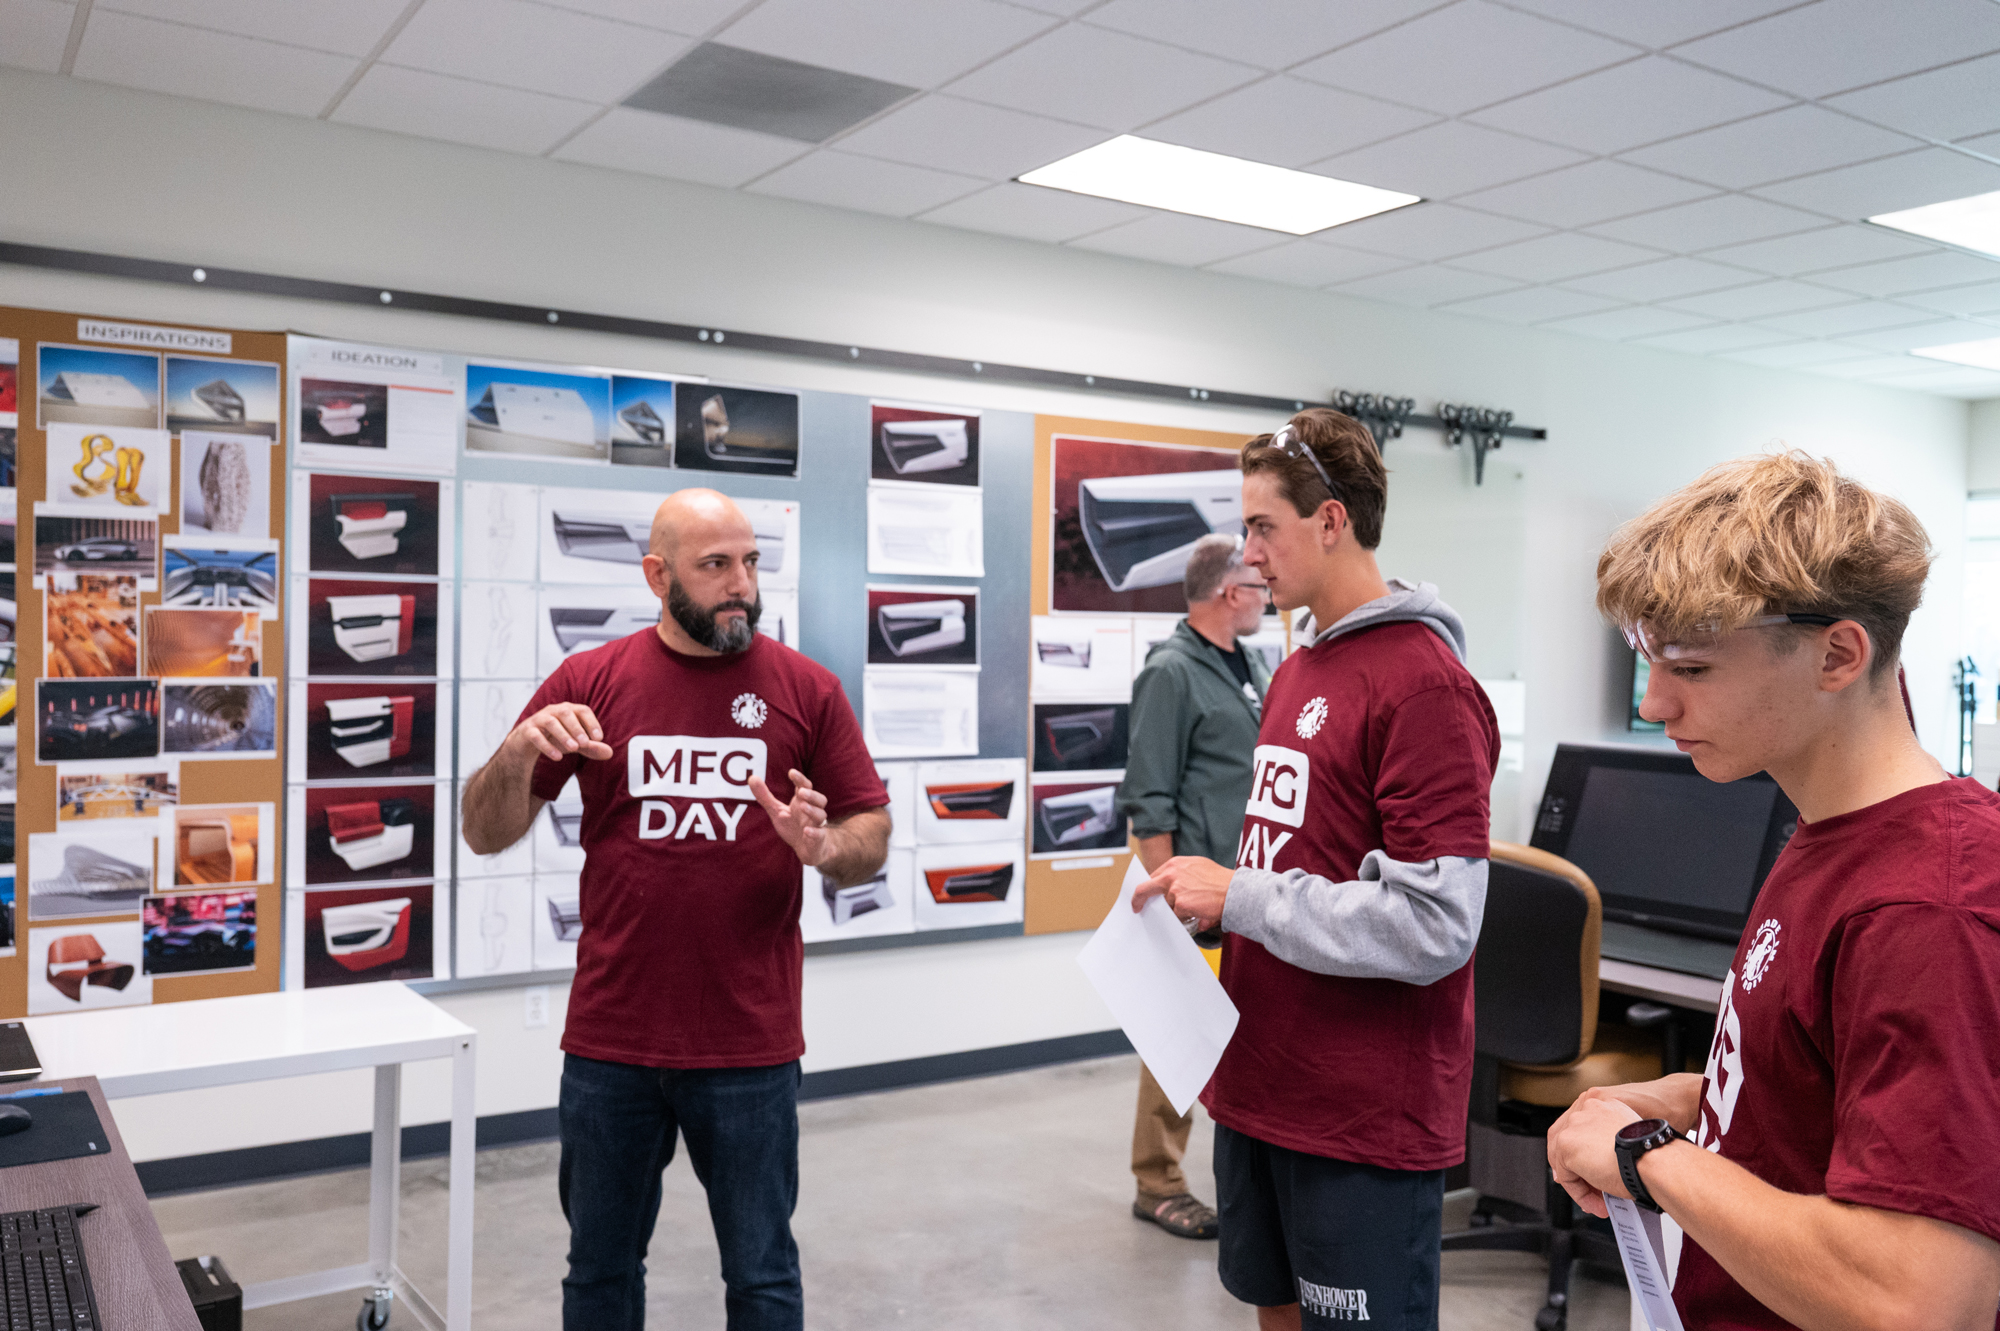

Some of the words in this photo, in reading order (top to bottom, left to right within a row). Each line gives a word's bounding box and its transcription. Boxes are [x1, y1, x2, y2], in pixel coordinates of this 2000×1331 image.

[84, 324, 229, 350] INSPIRATIONS
[331, 350, 417, 369] IDEATION
[643, 749, 754, 786] MFG
[638, 800, 748, 841] DAY
[1236, 823, 1294, 871] AY
[1308, 1300, 1353, 1321] TENNIS
